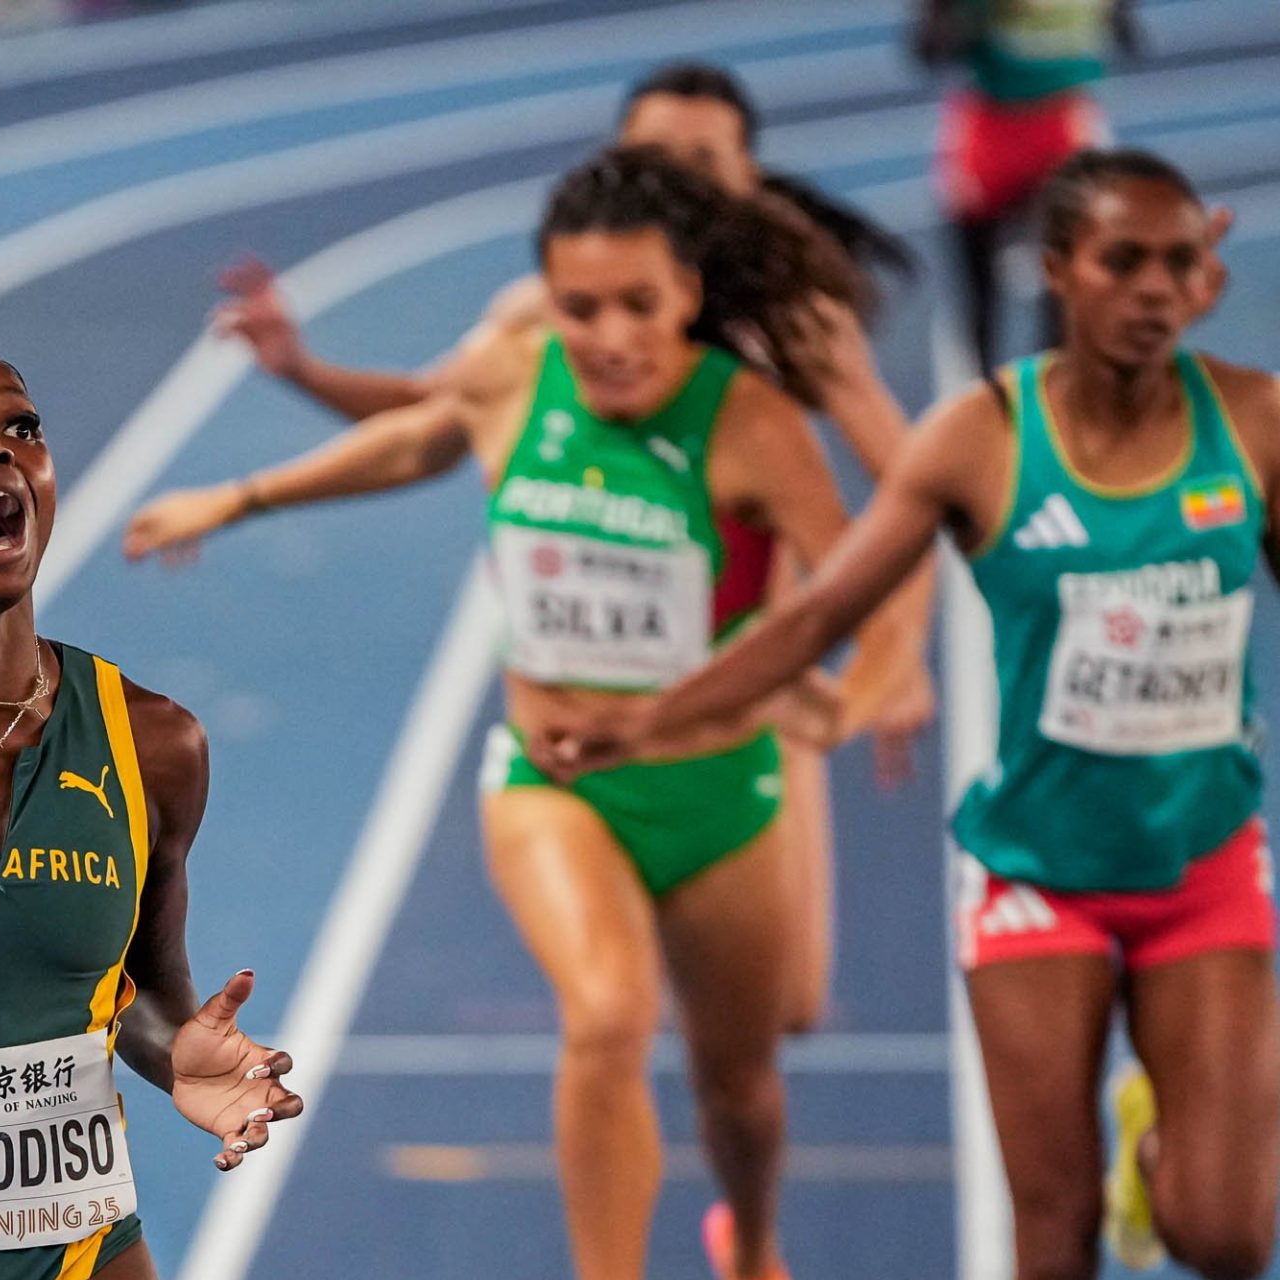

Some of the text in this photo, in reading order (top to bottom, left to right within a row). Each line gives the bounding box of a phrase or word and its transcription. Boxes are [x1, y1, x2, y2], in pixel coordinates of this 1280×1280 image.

[530, 592, 668, 641] SILVA
[2, 847, 120, 889] AFRICA
[3, 1101, 20, 1113] OF
[26, 1091, 78, 1110] NANJING
